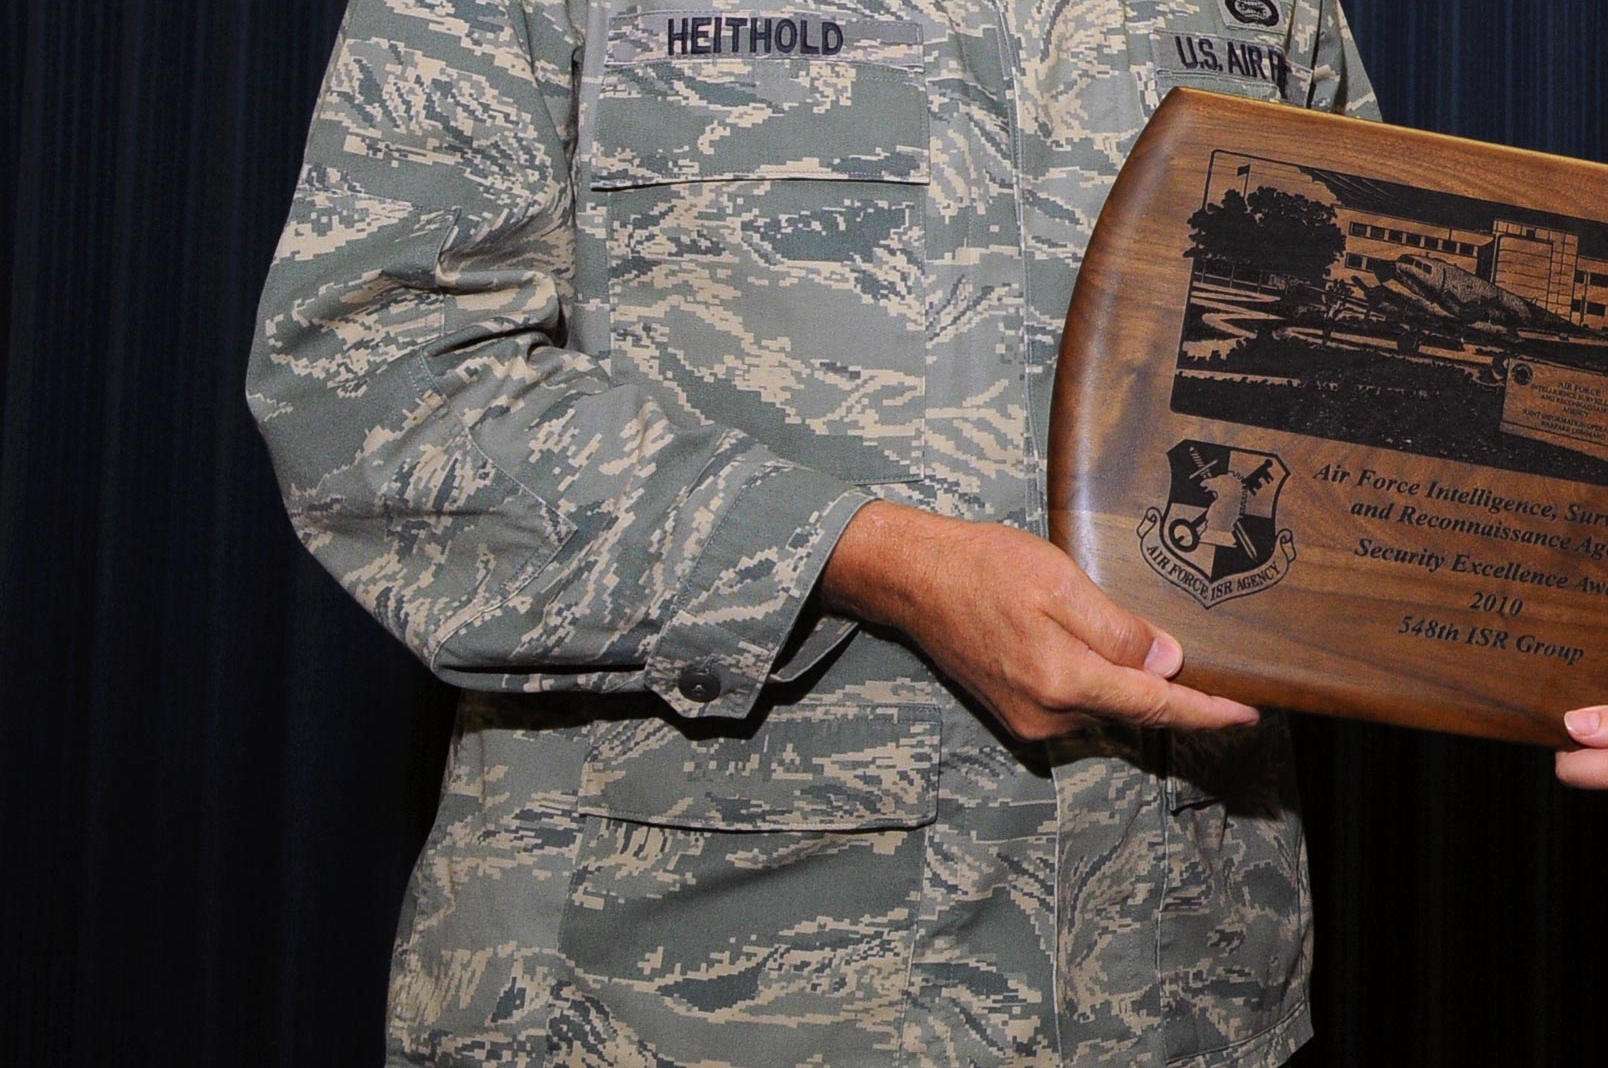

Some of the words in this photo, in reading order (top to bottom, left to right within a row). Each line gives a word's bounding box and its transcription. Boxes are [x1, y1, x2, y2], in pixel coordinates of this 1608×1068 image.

[667, 16, 844, 56] HEITHOLD
[1174, 35, 1224, 72] U.S.
[1227, 41, 1267, 80] AIR
[1312, 464, 1351, 484] Air
[1356, 468, 1420, 496] Force
[1424, 481, 1557, 521] Intelligence,
[1350, 501, 1395, 521] and
[1398, 505, 1572, 550] Reconnaissance
[1146, 545, 1170, 571] AIR
[1168, 563, 1209, 600] FORCE
[1210, 582, 1233, 602] ISR
[1236, 562, 1281, 591] AGENCY
[1354, 538, 1445, 573] Security
[1451, 553, 1569, 589] Excellence
[1469, 591, 1523, 617] 2010
[1398, 615, 1461, 642] 548th
[1464, 626, 1510, 650] ISR
[1516, 634, 1585, 667] Group
